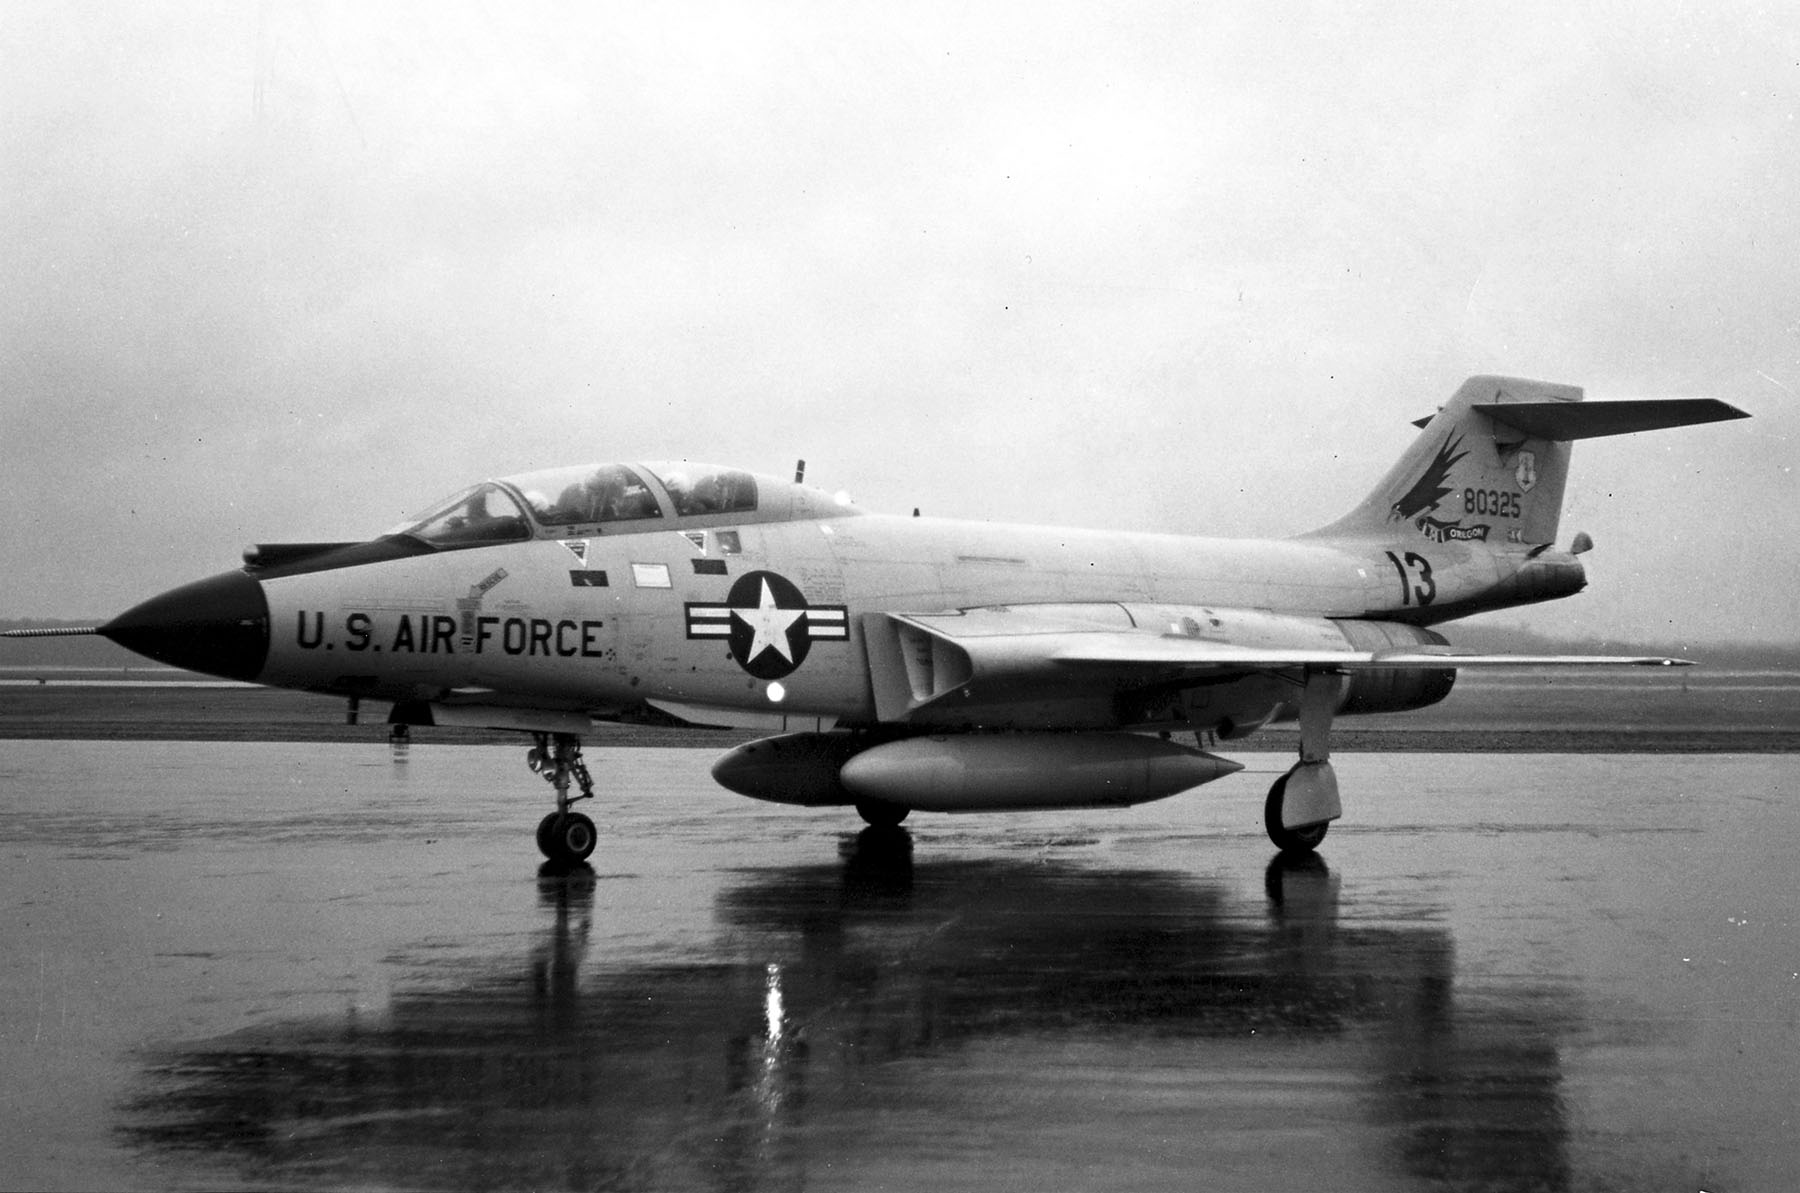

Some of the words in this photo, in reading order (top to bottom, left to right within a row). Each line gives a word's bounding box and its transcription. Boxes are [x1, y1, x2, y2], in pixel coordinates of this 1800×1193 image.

[1465, 488, 1521, 518] 80325
[1449, 527, 1485, 539] OREGON
[1385, 551, 1436, 606] 13
[391, 614, 457, 654] AIR
[475, 616, 604, 658] FORCE
